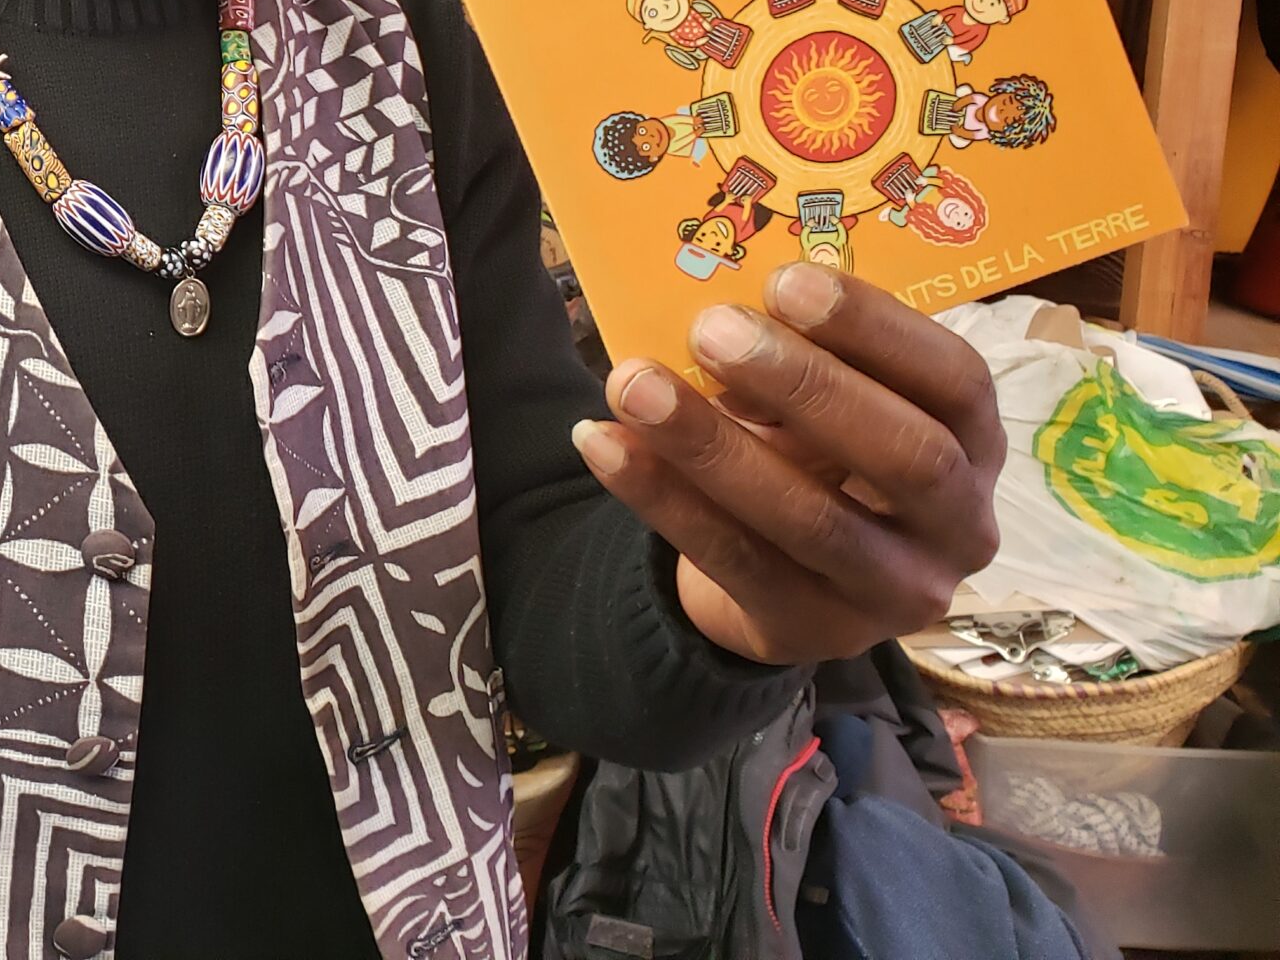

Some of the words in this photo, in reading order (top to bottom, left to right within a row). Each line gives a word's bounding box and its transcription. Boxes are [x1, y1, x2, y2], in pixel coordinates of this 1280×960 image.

[959, 256, 1003, 289] DE
[1003, 243, 1045, 274] LA
[1046, 204, 1150, 256] TERRE
